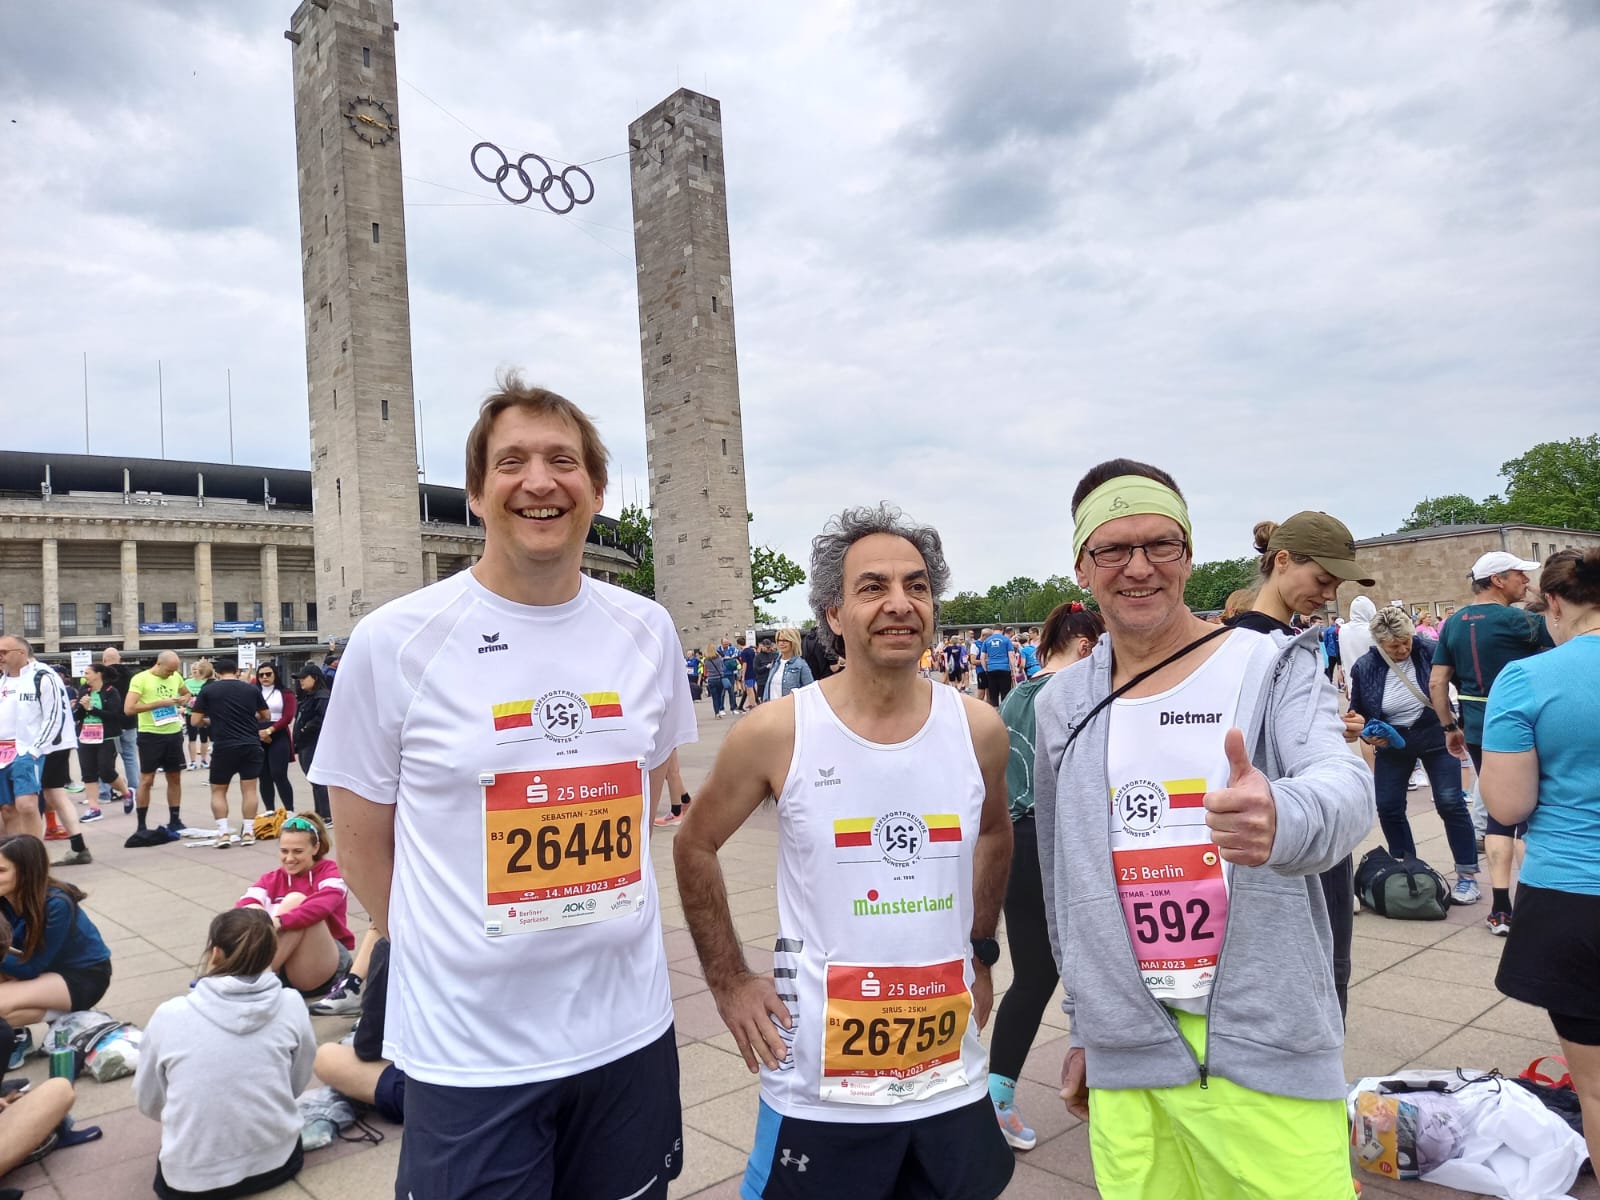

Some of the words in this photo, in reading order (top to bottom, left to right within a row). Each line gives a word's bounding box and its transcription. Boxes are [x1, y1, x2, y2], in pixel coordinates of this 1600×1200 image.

[478, 642, 509, 654] erima
[534, 690, 588, 716] LAUFSPORTFREUNDE
[1160, 711, 1222, 726] Dietmar
[544, 733, 572, 744] MÜNSTER
[814, 778, 842, 788] erima
[557, 787, 575, 800] 25
[580, 782, 618, 798] Berlin
[1114, 780, 1166, 806] LAUFSPORTFREUNDE
[541, 811, 583, 822] SEBASTIAN
[588, 808, 608, 817] 25KM
[873, 811, 928, 836] LAUFSPORTFREUNDE
[490, 832, 504, 841] B3
[1123, 826, 1150, 838] MÜNSTER
[506, 816, 632, 874] 26448
[1120, 867, 1138, 880] 25
[1142, 864, 1184, 878] Berlin
[546, 889, 561, 898] 14.
[564, 886, 583, 896] MAI
[586, 881, 608, 893] 2023
[519, 909, 542, 917] Berliner
[562, 902, 586, 913] AOK
[519, 916, 549, 925] Sparkasse
[1121, 898, 1215, 944] 592
[1140, 961, 1160, 969] MAI
[1162, 960, 1186, 969] 2023
[888, 984, 904, 996] 25
[909, 982, 946, 996] Berlin
[830, 1018, 840, 1026] B1
[842, 1010, 956, 1056] 26759
[890, 1070, 905, 1079] MAI
[906, 1064, 924, 1077] 2023
